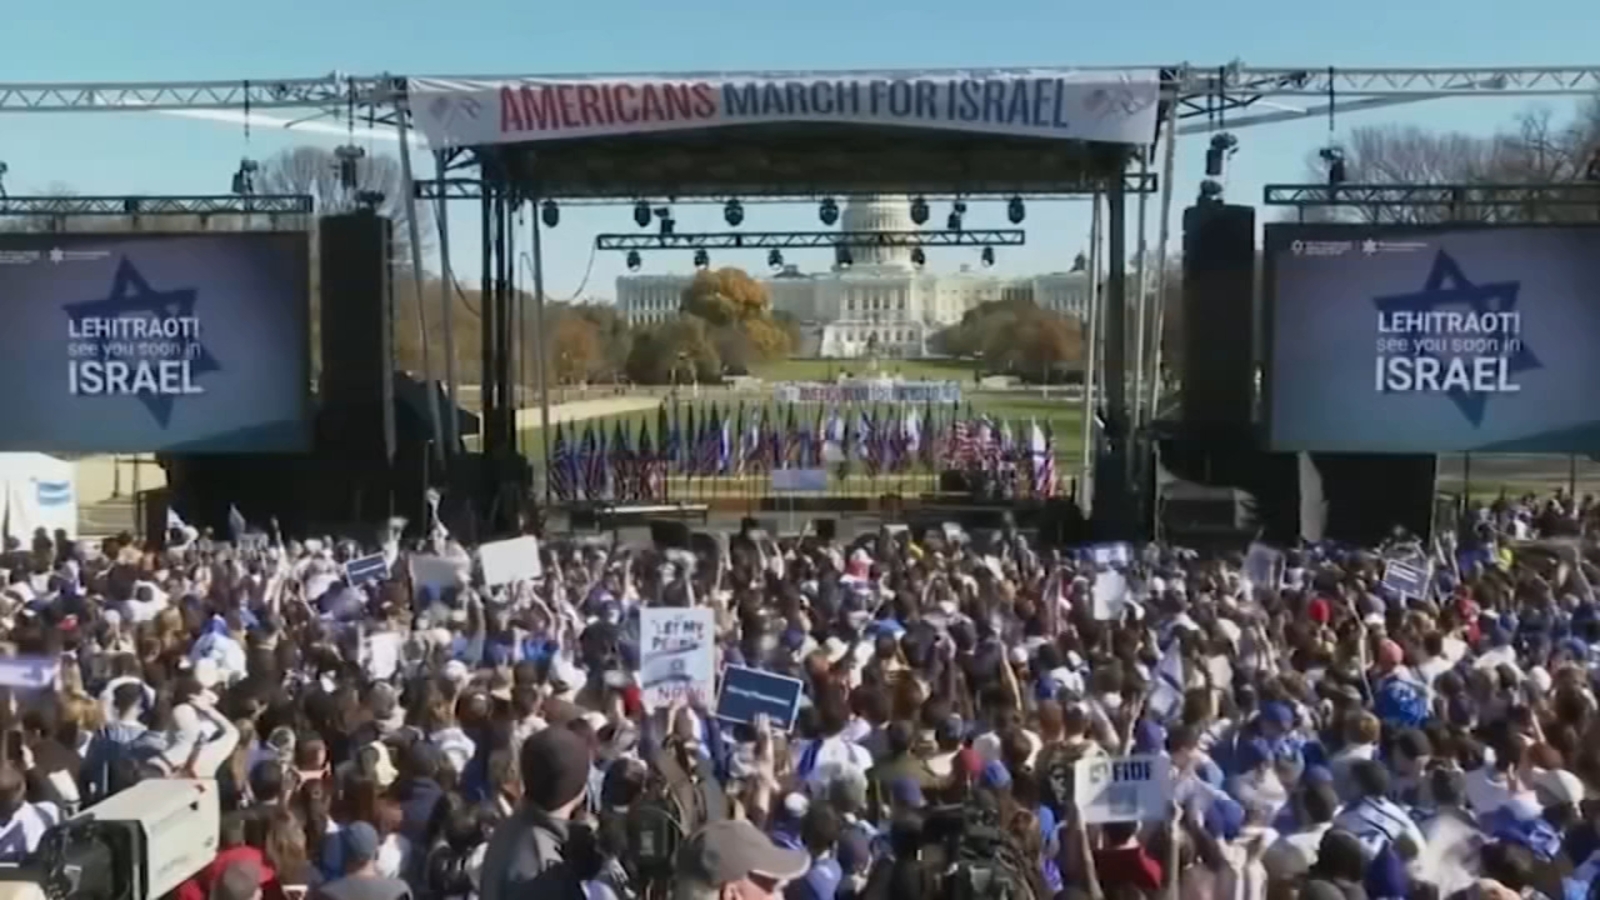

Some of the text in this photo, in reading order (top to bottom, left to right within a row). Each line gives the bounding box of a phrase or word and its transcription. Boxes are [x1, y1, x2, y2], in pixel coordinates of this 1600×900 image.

[500, 78, 1068, 132] AMERICANS MARCH FOR ISRAEL
[67, 340, 200, 360] see you soon in
[1376, 334, 1520, 355] see you soon in
[69, 360, 204, 394] ISRAEL
[1375, 356, 1521, 391] ISRAEL
